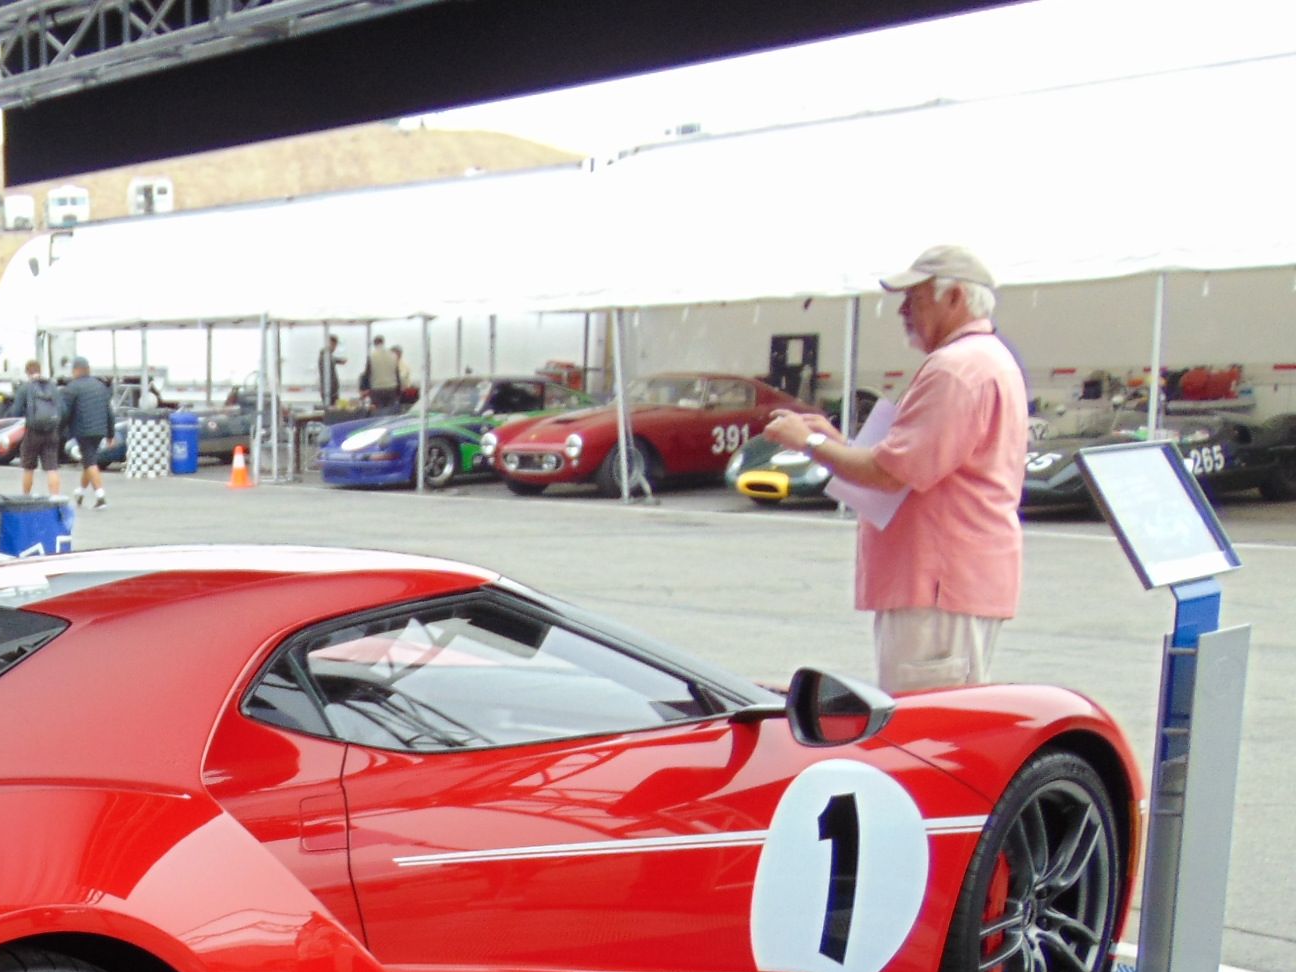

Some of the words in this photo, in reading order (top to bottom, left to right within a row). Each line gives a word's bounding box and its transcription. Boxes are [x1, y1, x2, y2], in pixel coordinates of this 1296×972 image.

[711, 424, 750, 455] 391
[1189, 445, 1226, 475] 265
[816, 791, 861, 966] 1
